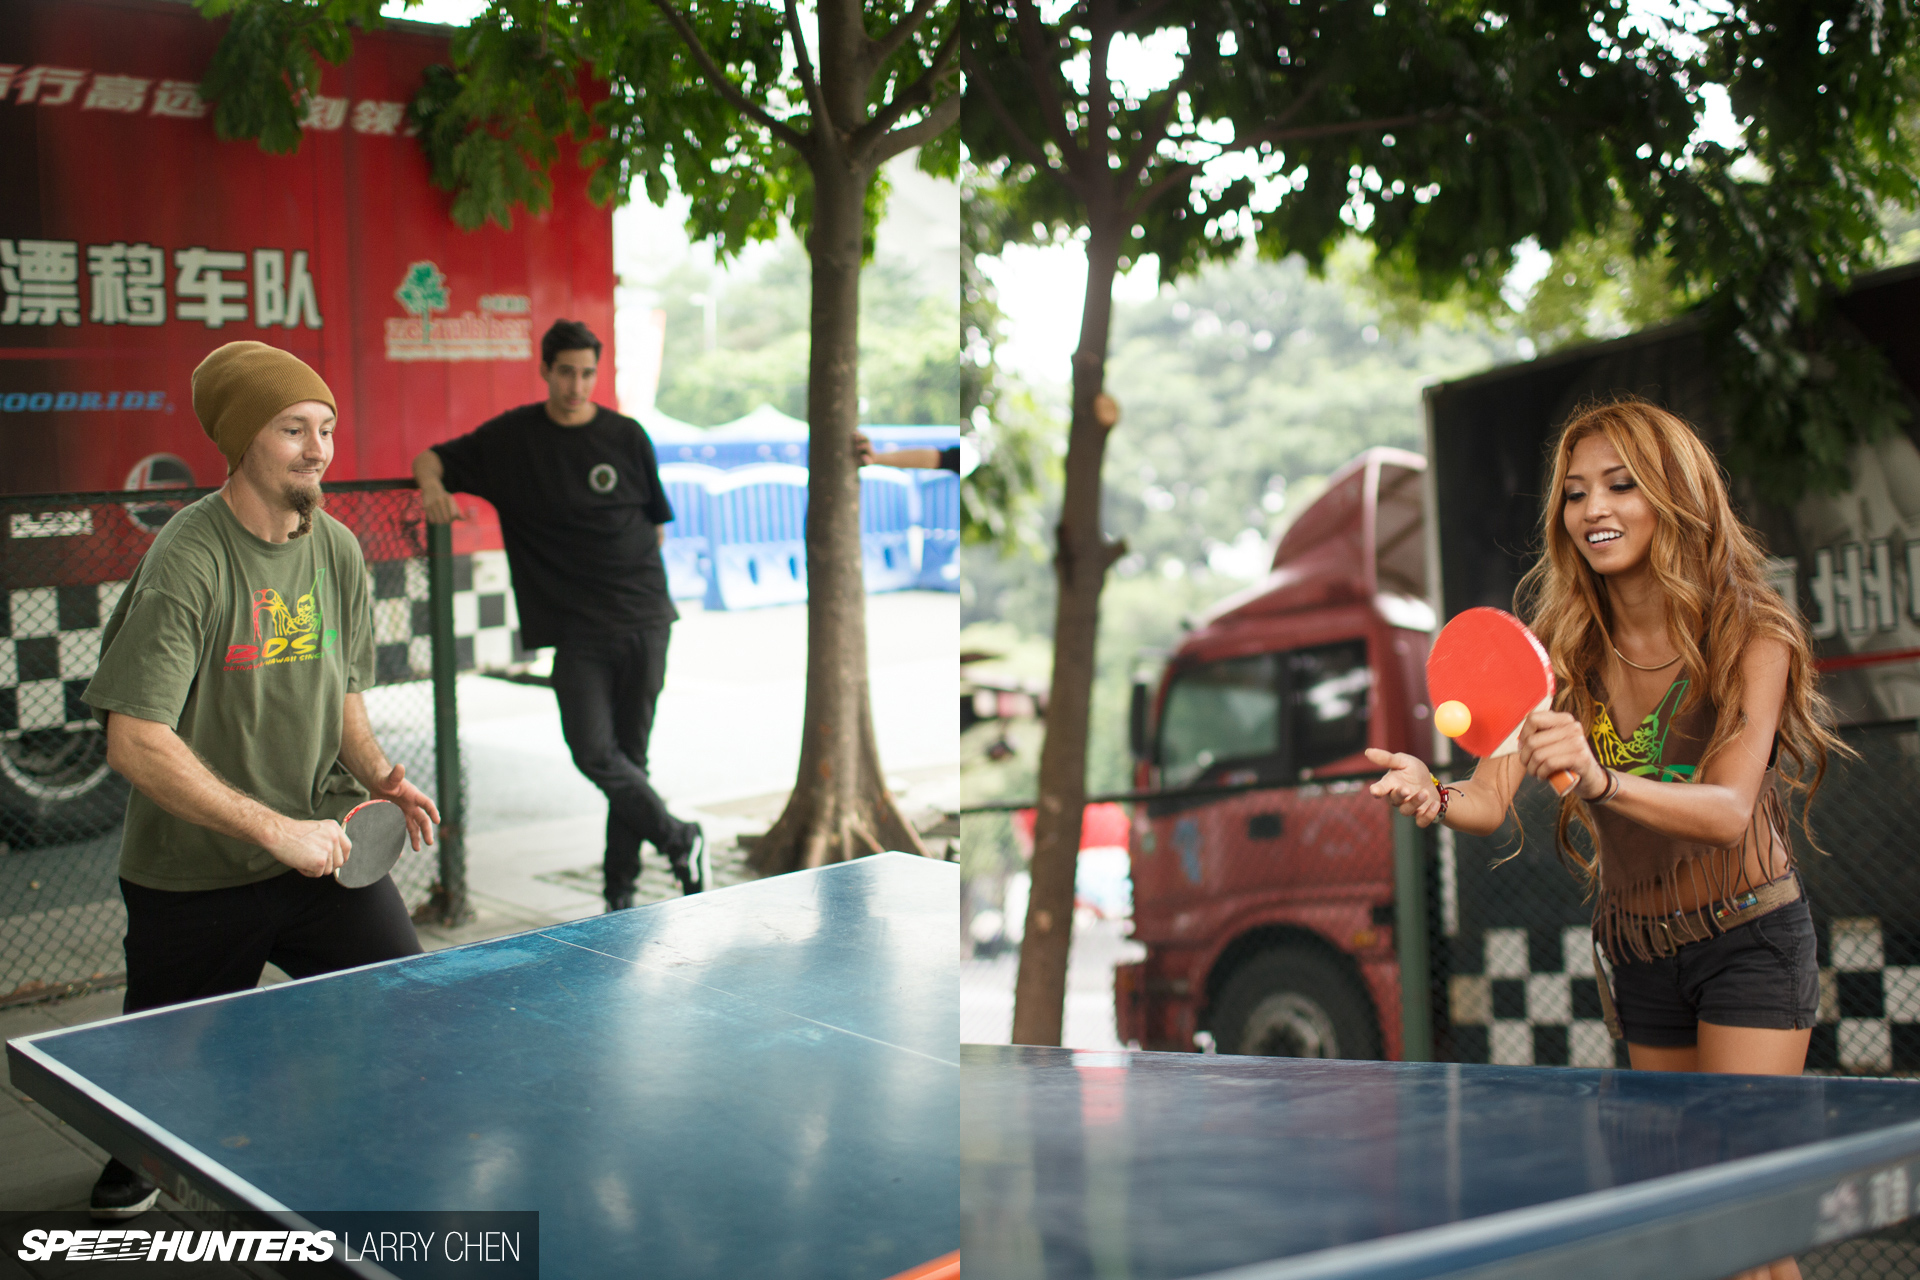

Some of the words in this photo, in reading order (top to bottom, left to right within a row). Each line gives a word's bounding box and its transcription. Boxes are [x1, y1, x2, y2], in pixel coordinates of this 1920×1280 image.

[0, 238, 323, 329] 漂移车队
[0, 391, 166, 412] OODRIDE
